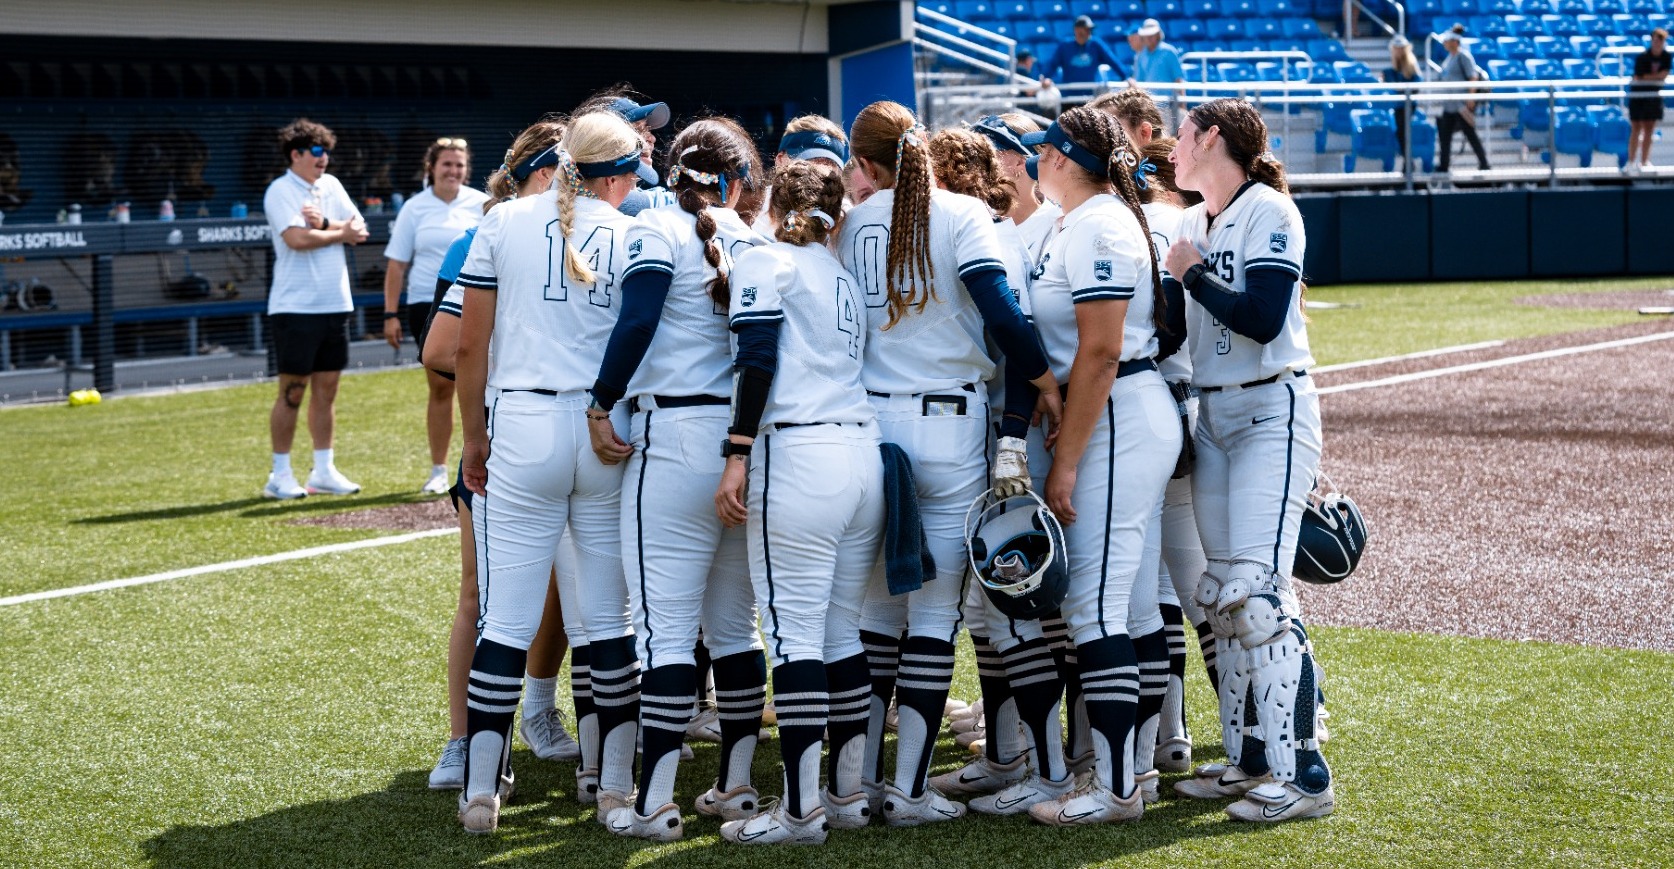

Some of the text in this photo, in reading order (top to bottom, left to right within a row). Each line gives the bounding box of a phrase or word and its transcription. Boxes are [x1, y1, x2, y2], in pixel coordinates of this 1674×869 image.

[24, 231, 87, 249] SOFTBALL
[198, 226, 243, 242] SHARKS
[544, 219, 614, 308] 14
[1204, 251, 1234, 283] KS
[837, 277, 859, 360] 4
